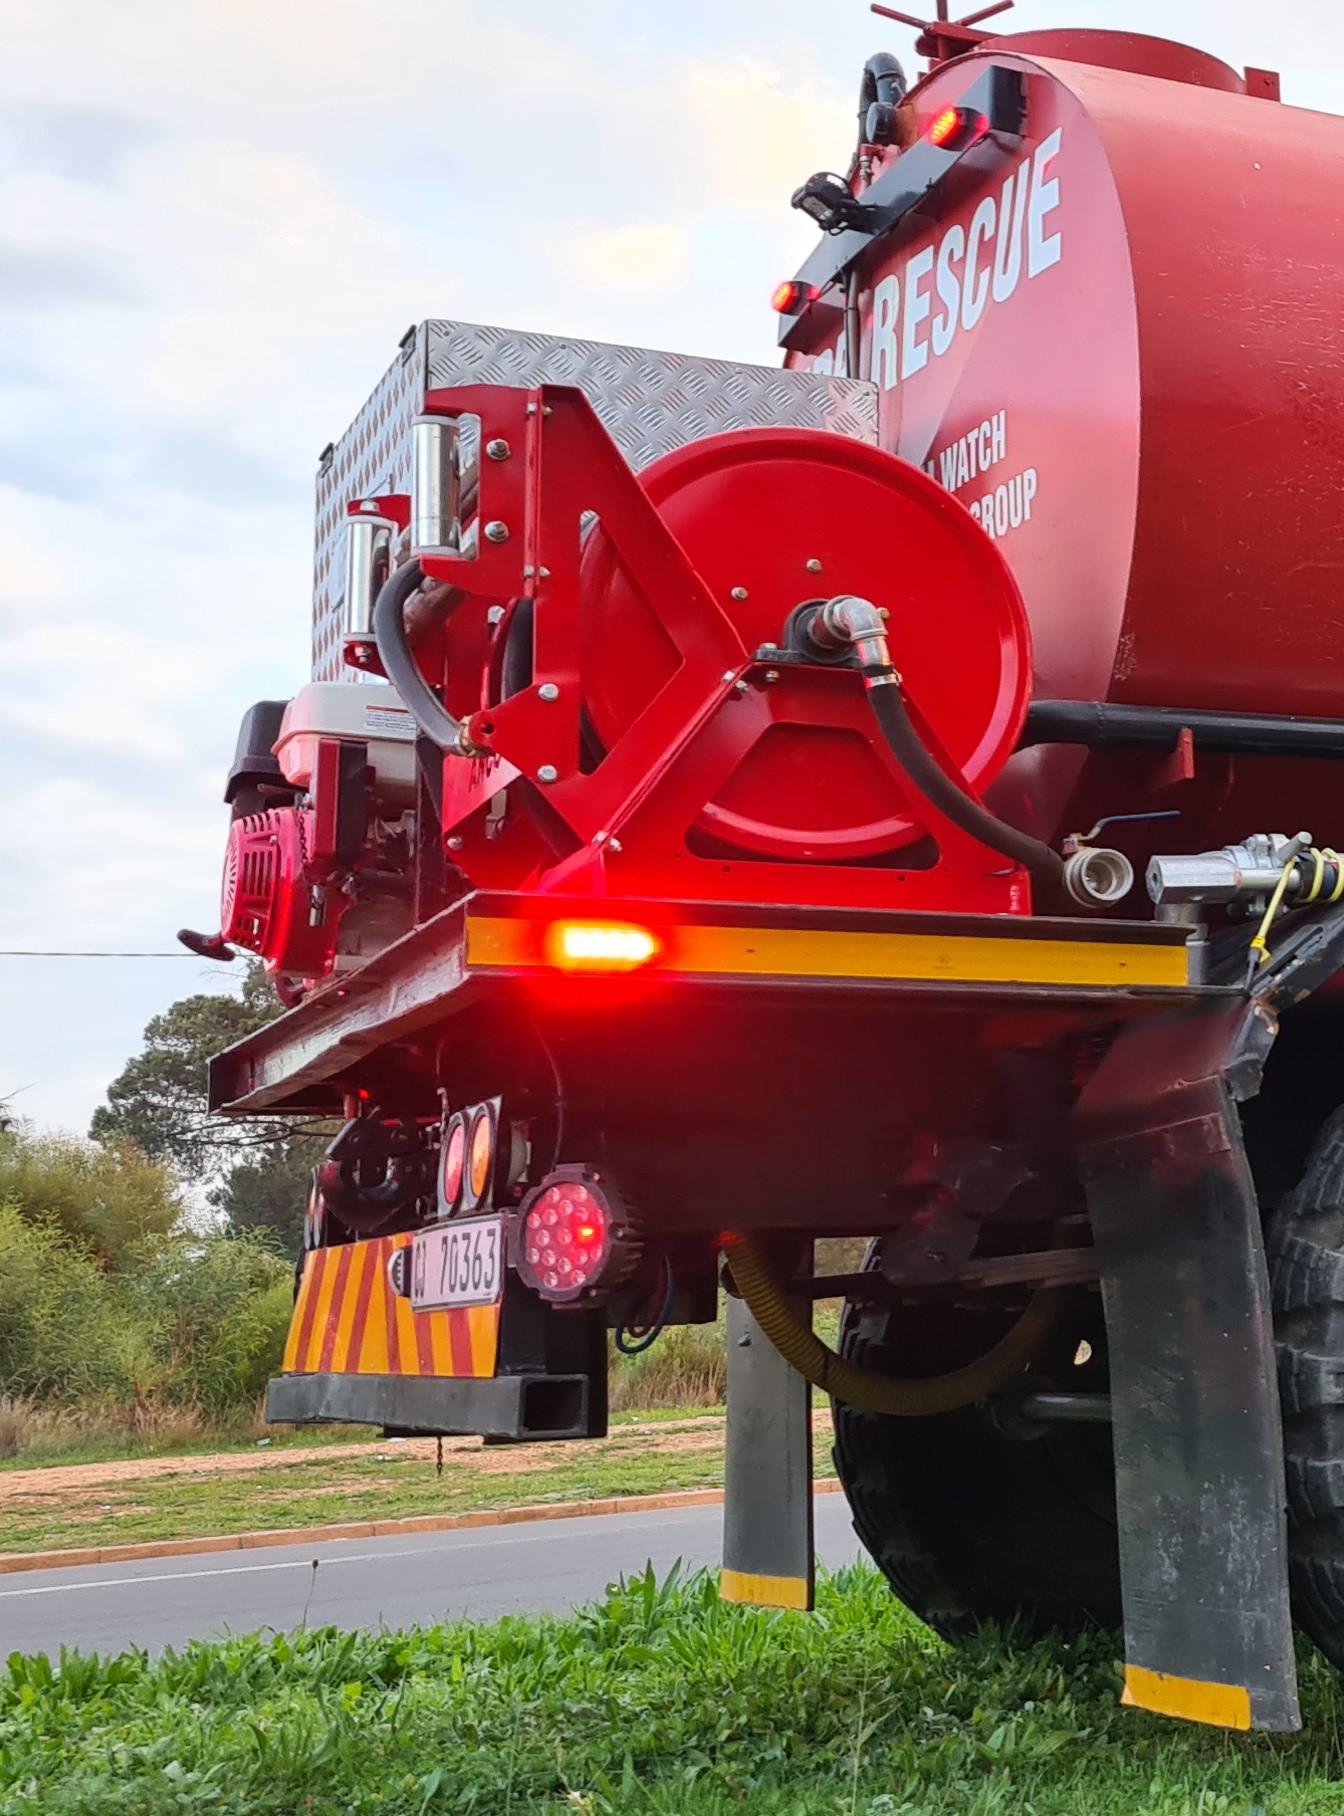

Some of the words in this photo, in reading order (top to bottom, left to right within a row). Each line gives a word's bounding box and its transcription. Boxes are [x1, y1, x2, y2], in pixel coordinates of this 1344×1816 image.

[871, 126, 1063, 392] RESCUE
[940, 409, 1006, 493] WATCH
[440, 1227, 497, 1296] 70363
